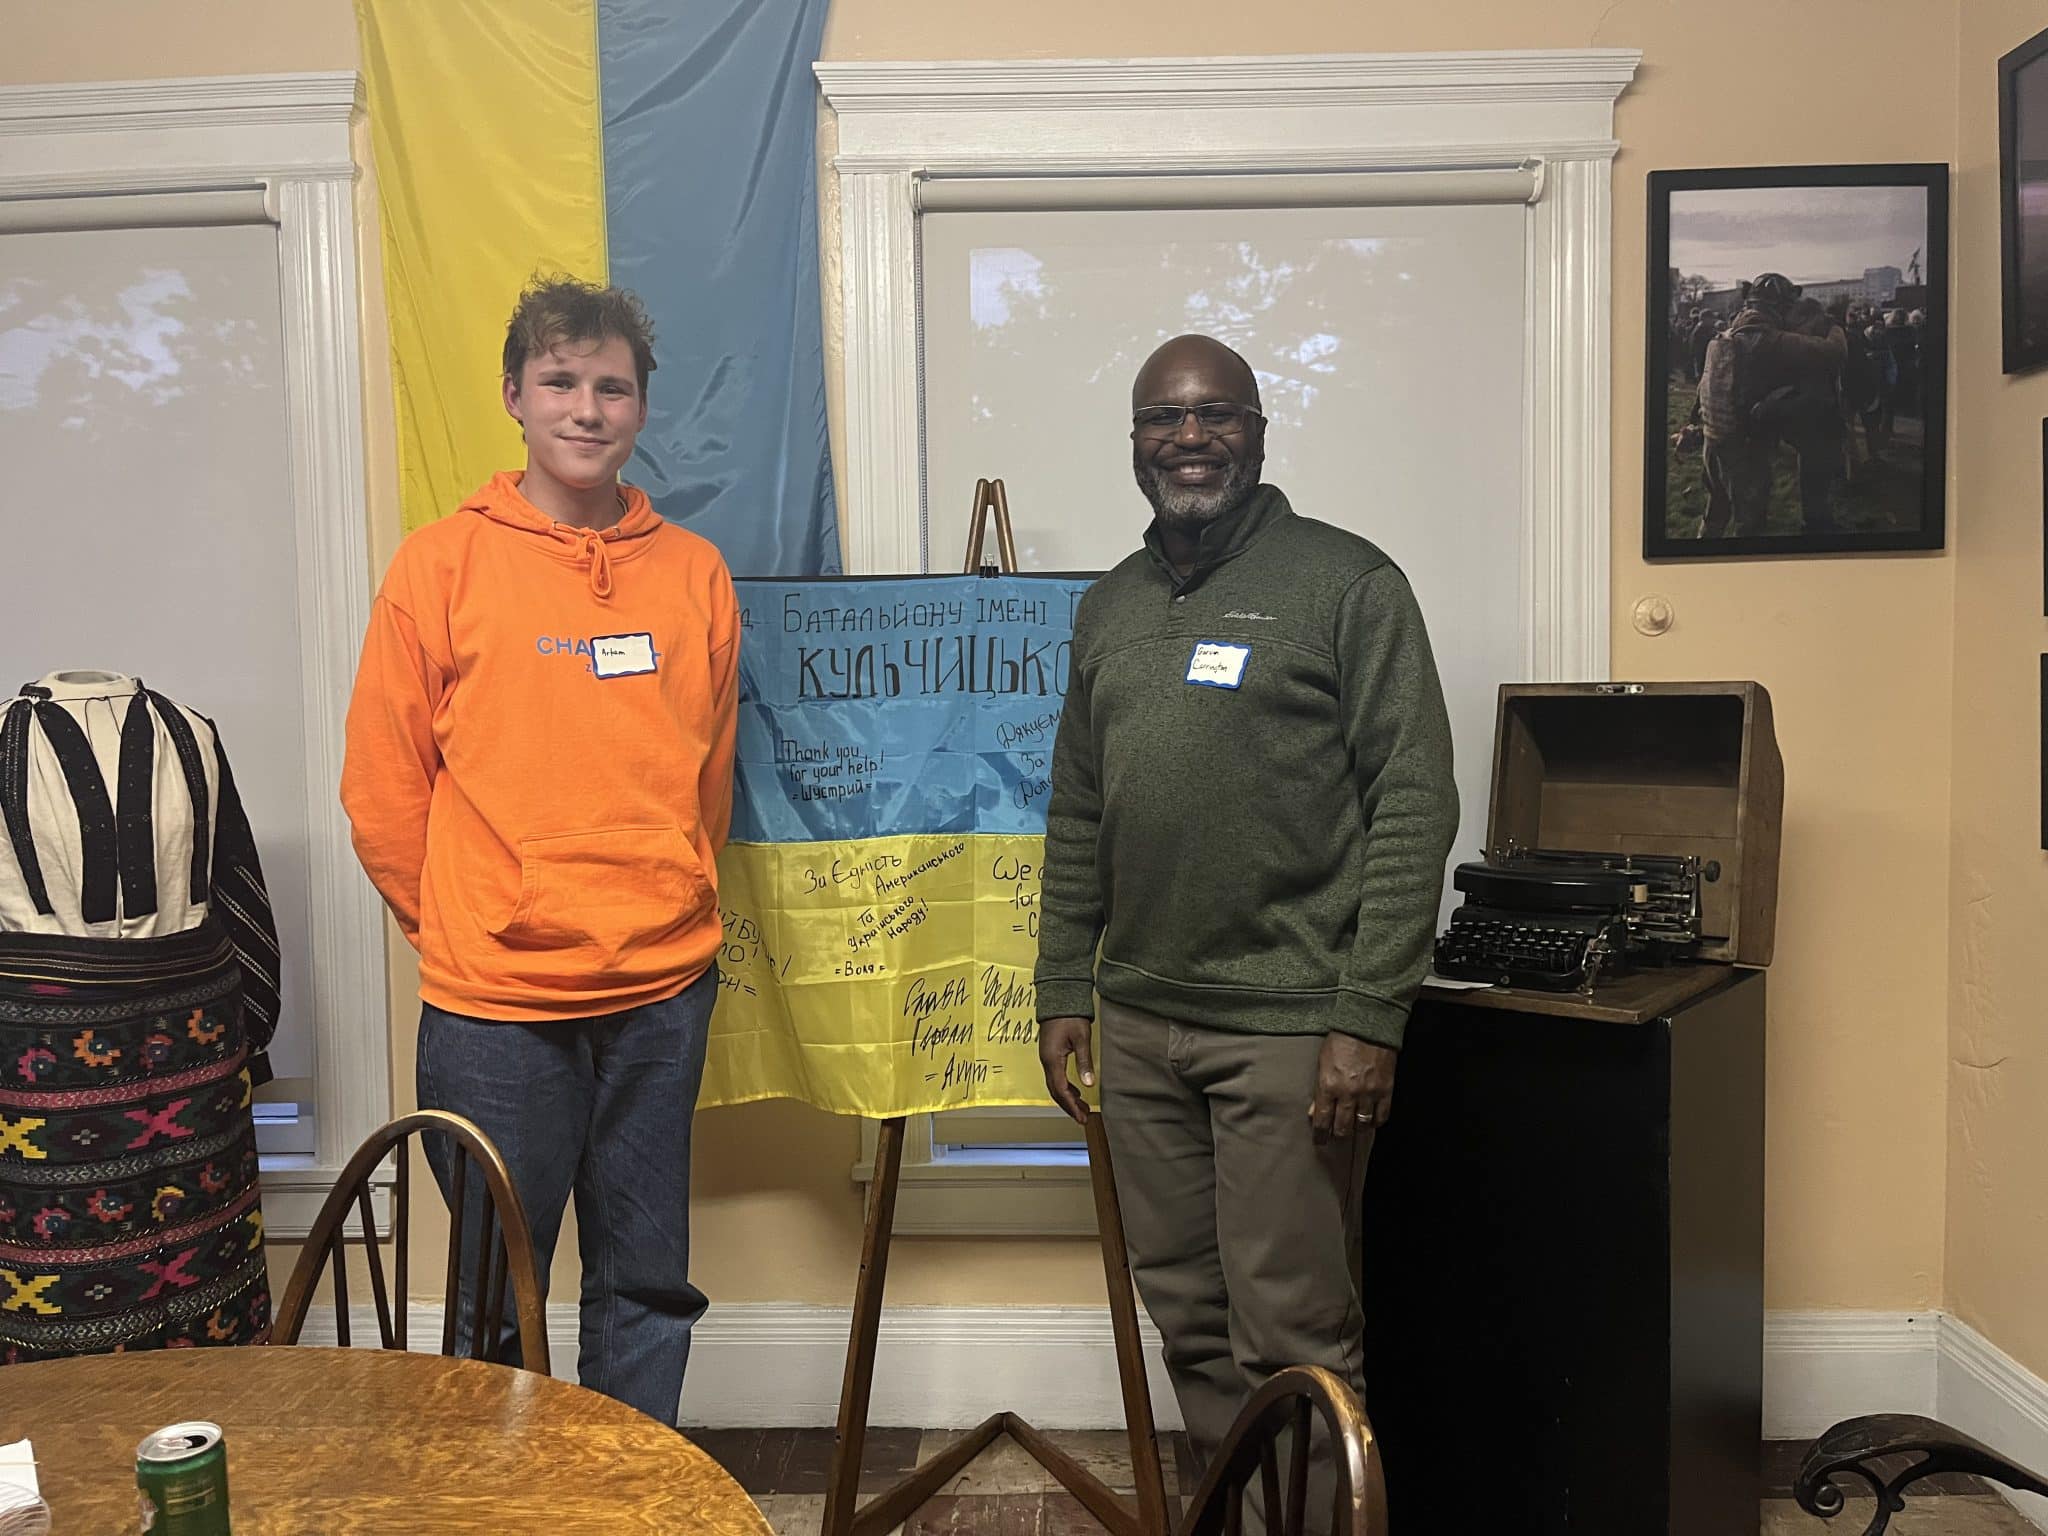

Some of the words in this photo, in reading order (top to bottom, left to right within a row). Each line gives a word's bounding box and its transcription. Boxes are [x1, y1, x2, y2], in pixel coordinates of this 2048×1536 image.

[798, 634, 1072, 699] КУЛЬЧИЦЬКО
[782, 739, 830, 762] Thank
[836, 746, 859, 767] you
[789, 763, 807, 782] for
[813, 764, 844, 784] your
[848, 748, 884, 779] help!
[992, 855, 1032, 881] We
[1009, 882, 1041, 910] for
